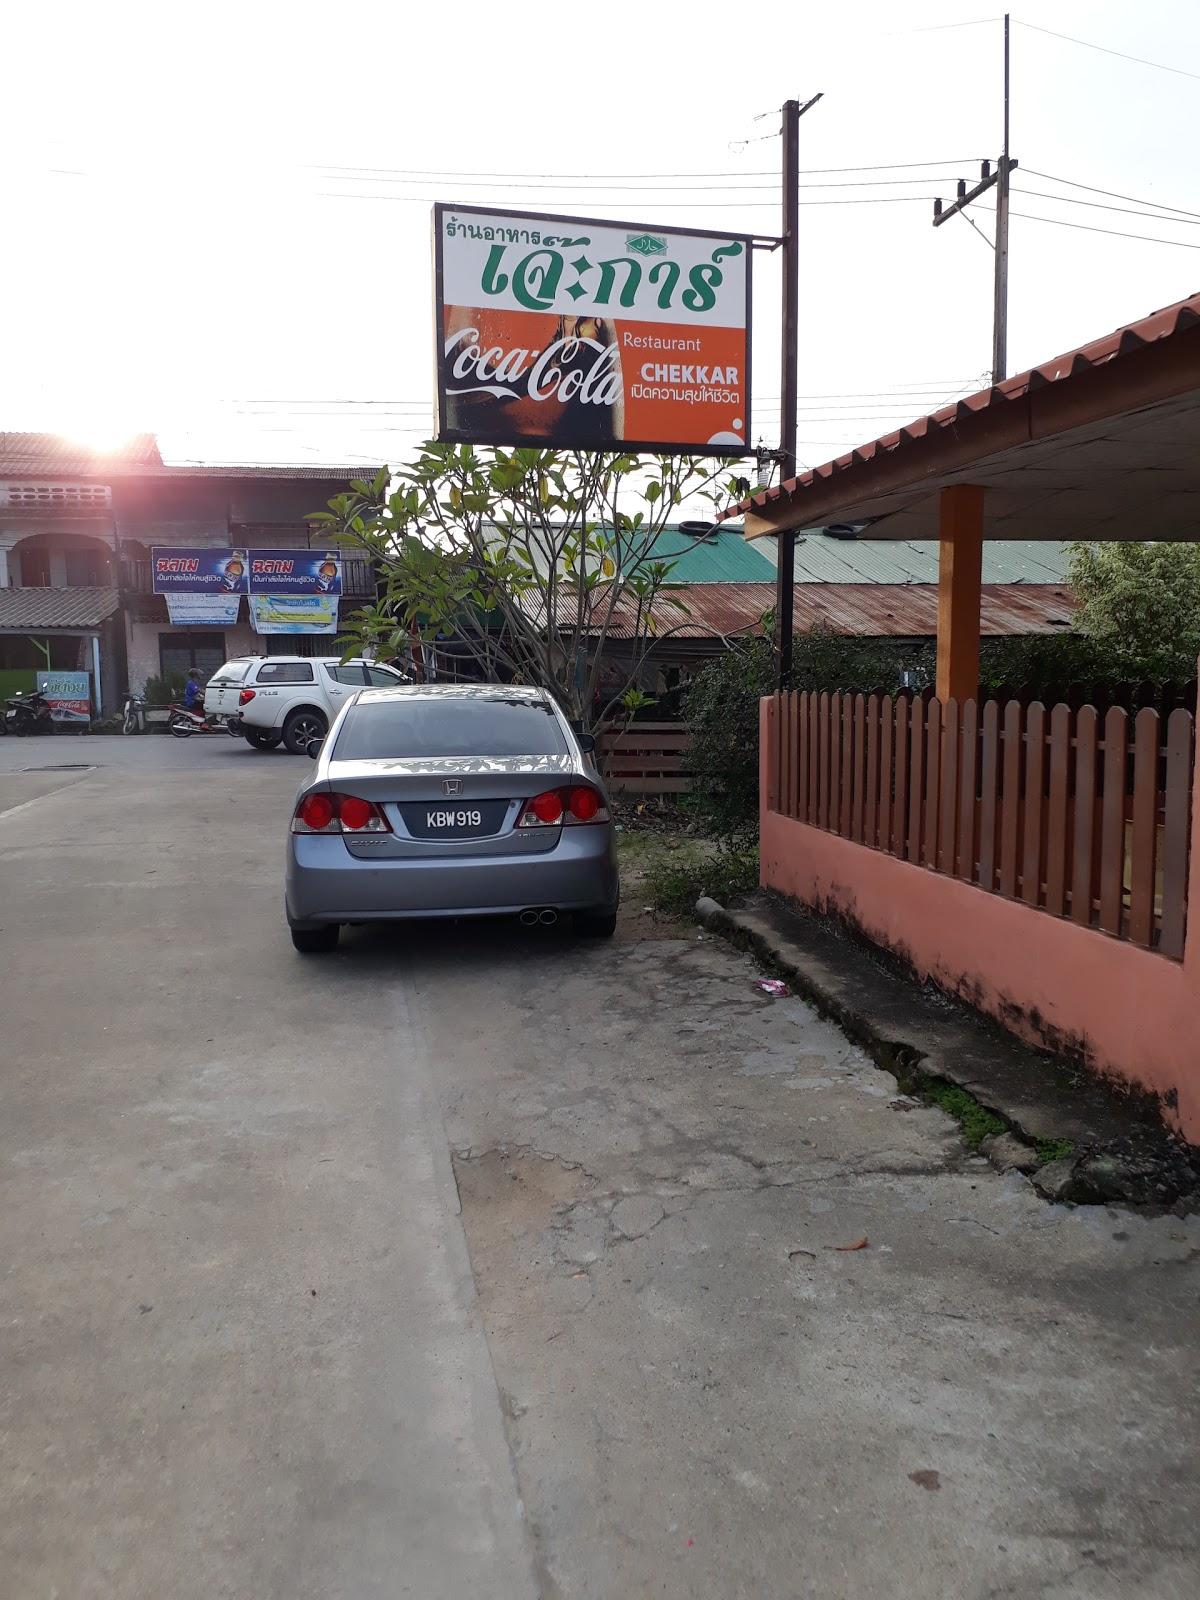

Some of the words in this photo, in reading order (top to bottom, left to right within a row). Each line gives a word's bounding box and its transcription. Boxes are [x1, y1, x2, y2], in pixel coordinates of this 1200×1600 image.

[446, 216, 541, 245] ร้านอาหาร
[623, 332, 701, 351] Restaurant
[445, 328, 621, 406] Coca-Cola
[640, 363, 739, 385] CHEKKAR
[631, 384, 740, 405] เปิดความสุขให้ชีวิต
[156, 558, 199, 573] ฉลาม
[252, 559, 294, 574] ฉลาม
